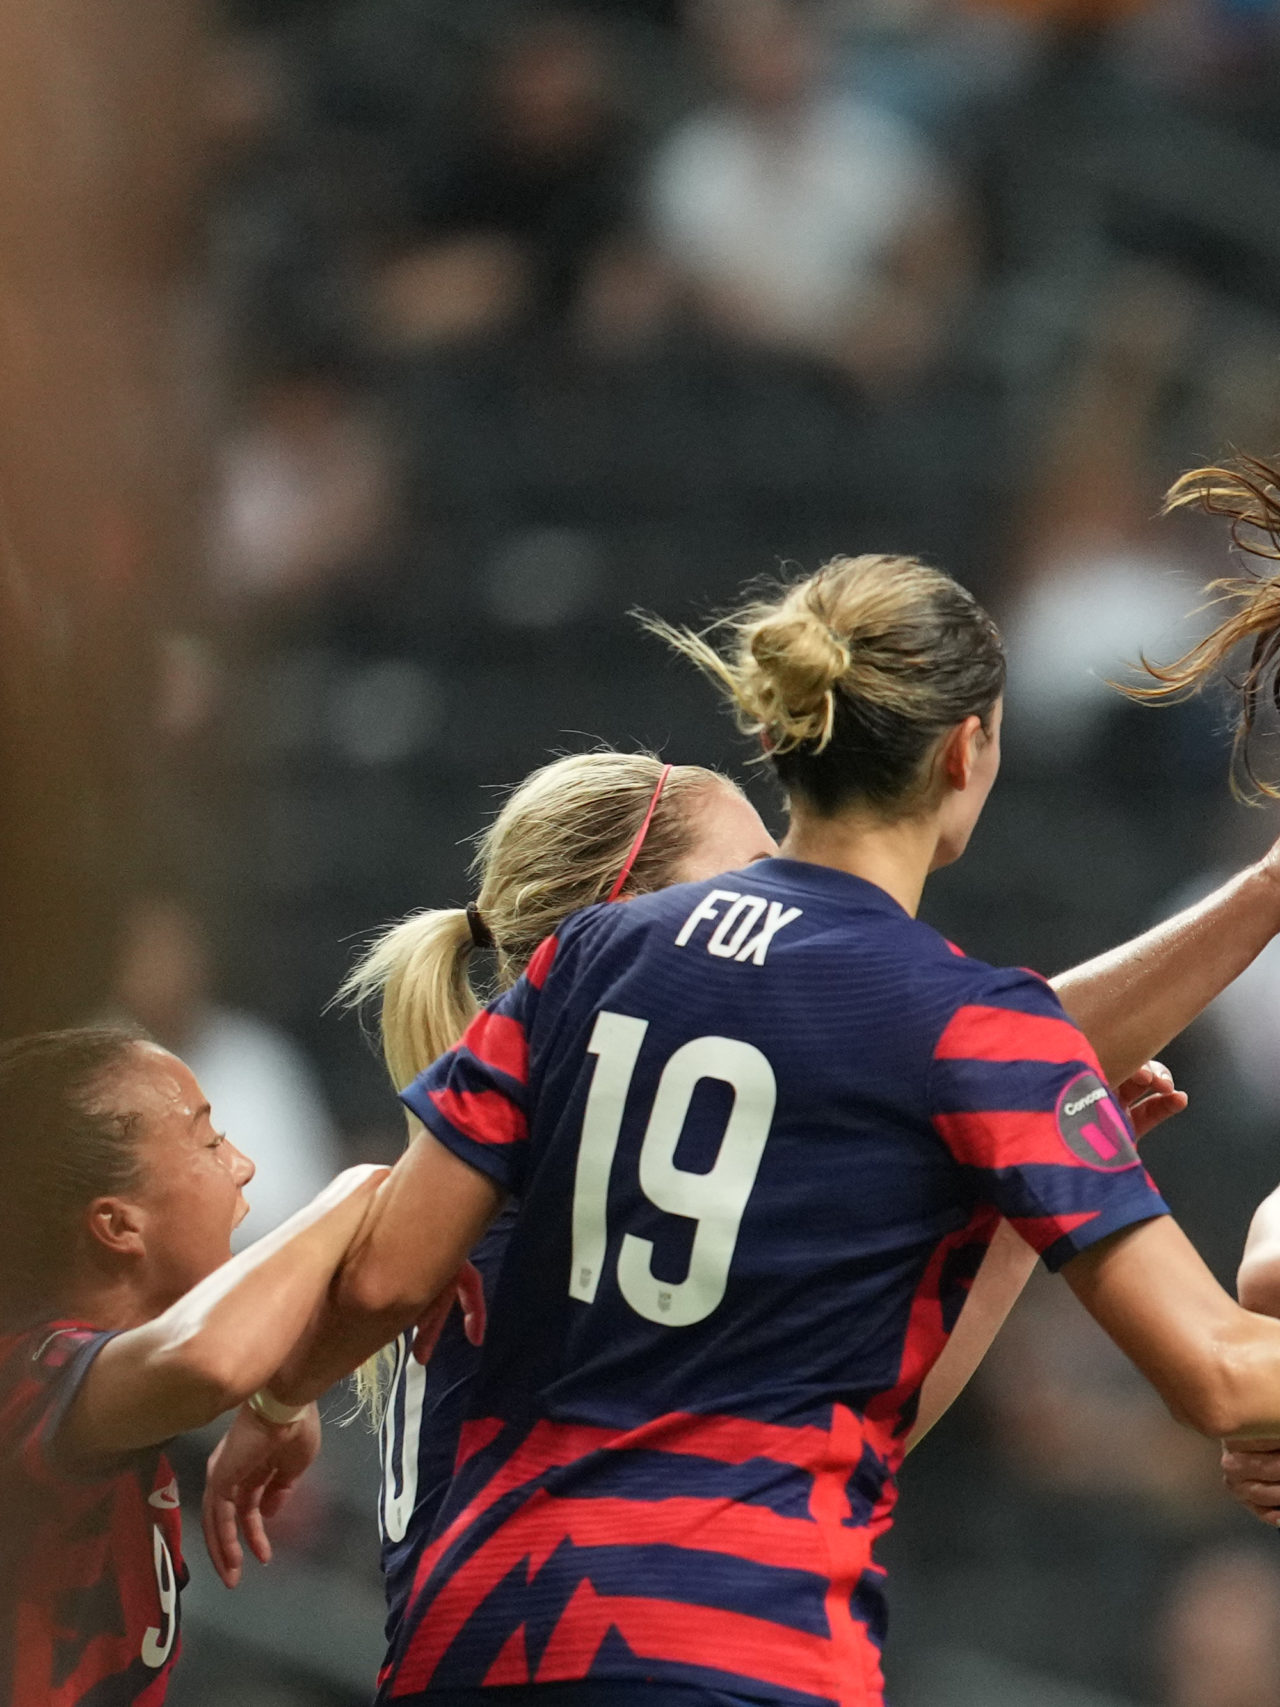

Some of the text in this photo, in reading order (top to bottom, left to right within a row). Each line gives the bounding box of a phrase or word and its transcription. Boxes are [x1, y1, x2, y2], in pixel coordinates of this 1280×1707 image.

[674, 889, 802, 967] FOX
[569, 1010, 778, 1328] 19
[141, 1523, 177, 1668] 9
